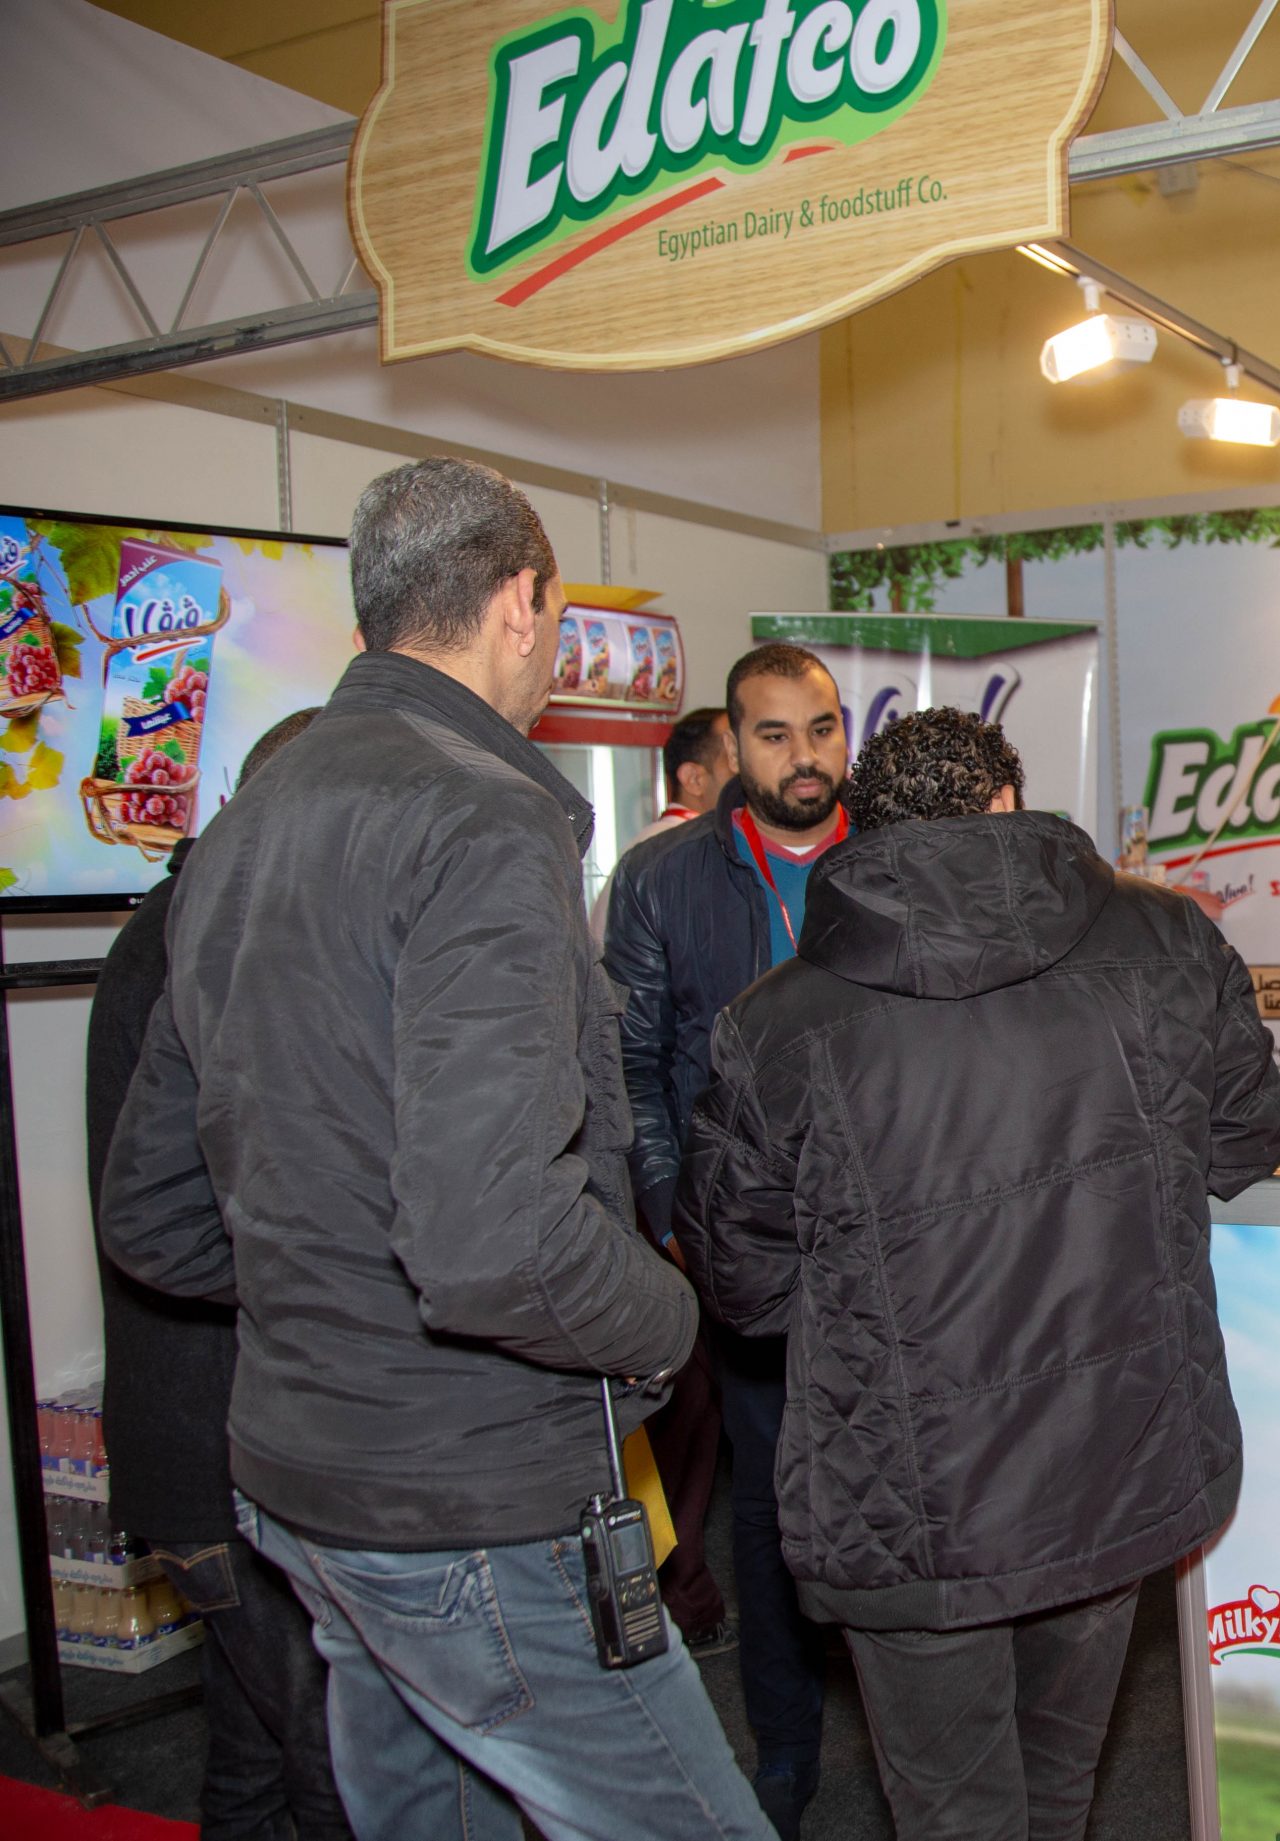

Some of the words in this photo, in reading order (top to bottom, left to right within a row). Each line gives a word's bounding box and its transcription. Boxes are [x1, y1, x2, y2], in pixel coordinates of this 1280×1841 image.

[487, 0, 922, 255] Edafco
[657, 220, 738, 261] Egyptian
[744, 208, 794, 238] Dairy
[799, 200, 814, 227] &
[819, 177, 914, 223] foodstuff
[917, 175, 948, 204] Co.
